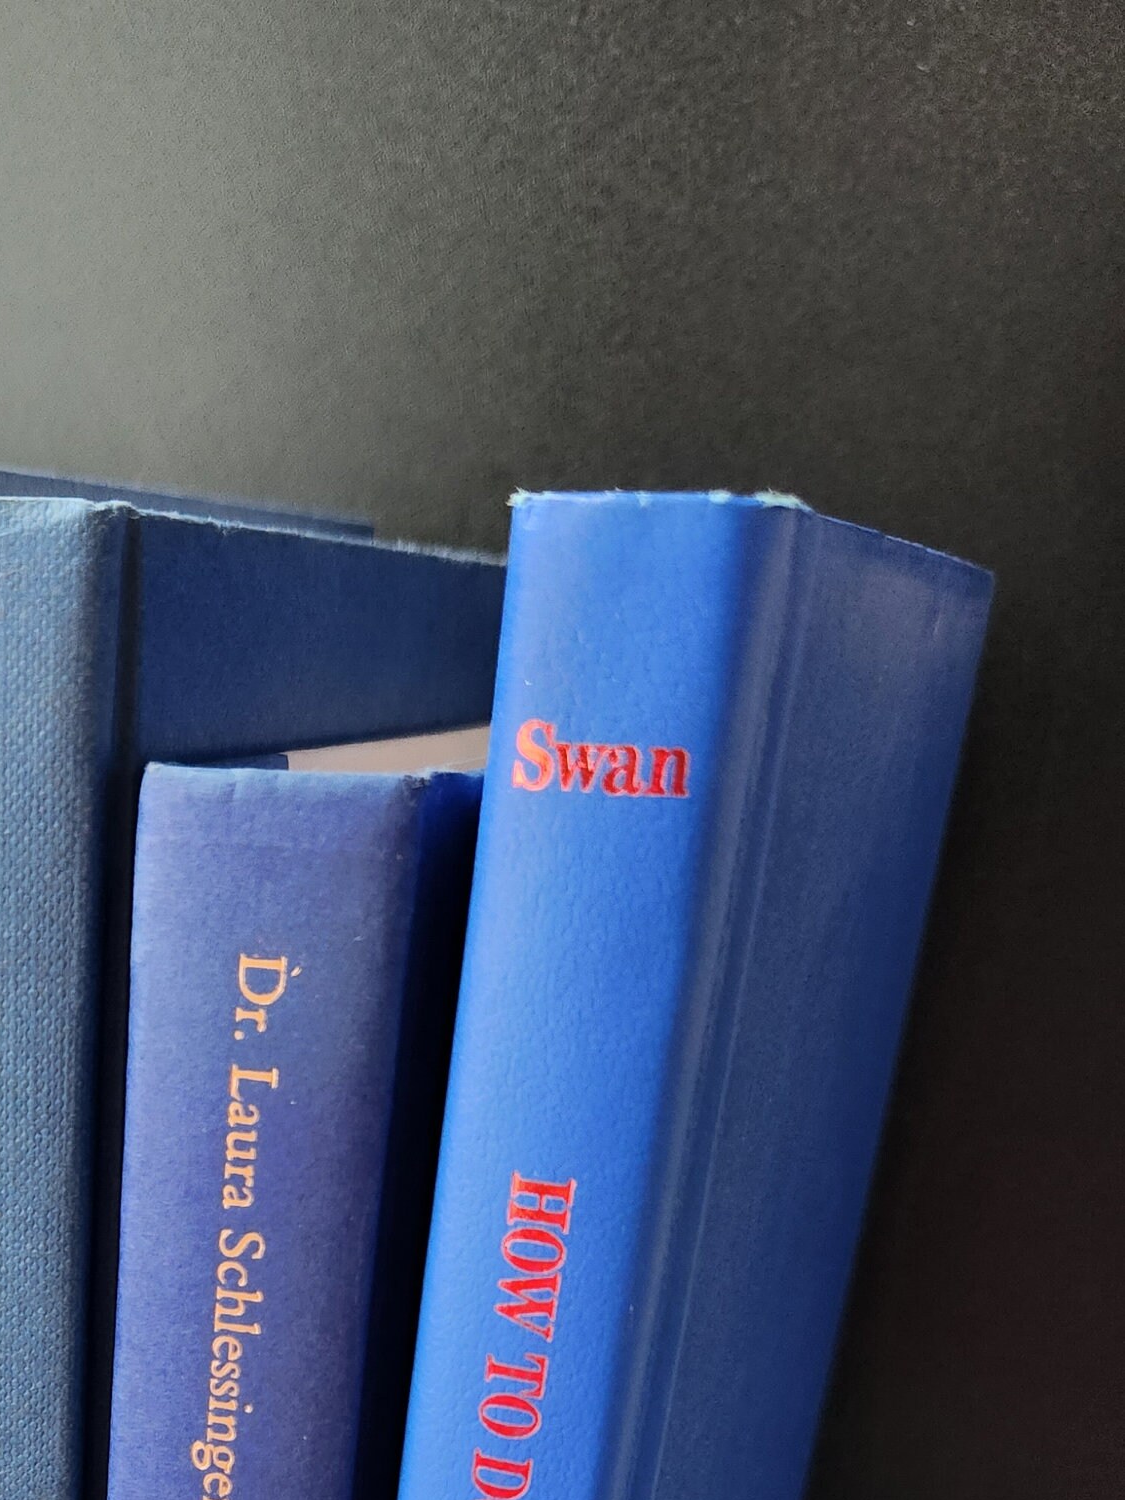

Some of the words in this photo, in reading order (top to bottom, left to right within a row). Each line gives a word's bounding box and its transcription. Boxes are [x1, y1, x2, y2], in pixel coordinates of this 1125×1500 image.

[512, 718, 690, 797] Swan
[233, 953, 288, 1041] Dr.
[221, 1064, 279, 1210] Laura
[493, 1170, 577, 1343] HOW
[478, 1352, 550, 1440] TO
